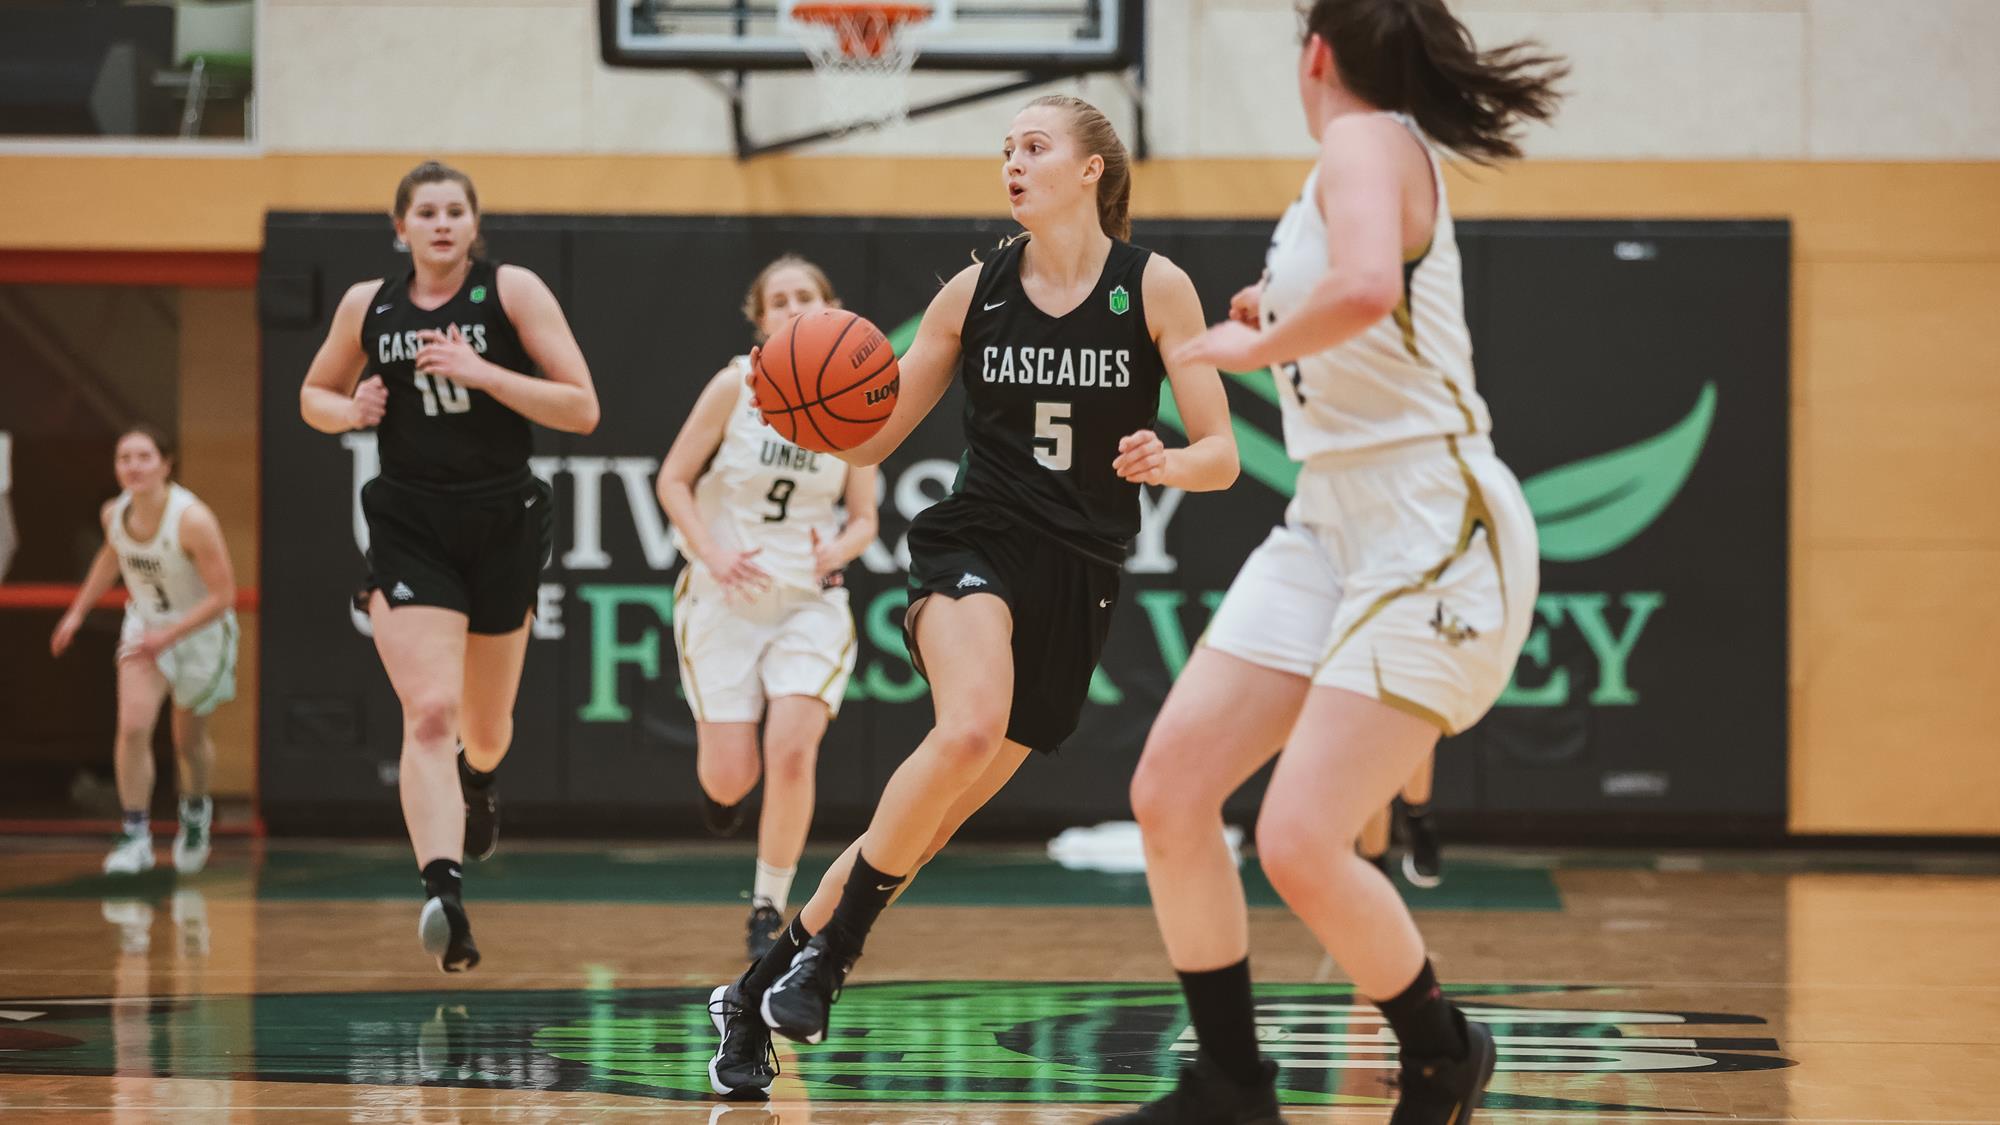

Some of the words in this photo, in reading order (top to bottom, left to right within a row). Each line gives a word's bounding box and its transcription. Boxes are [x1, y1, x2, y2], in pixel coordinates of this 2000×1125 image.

[378, 323, 488, 364] CASES
[982, 345, 1131, 388] CASCADES
[413, 370, 472, 417] 10
[1033, 401, 1073, 471] 5
[763, 478, 796, 523] 9
